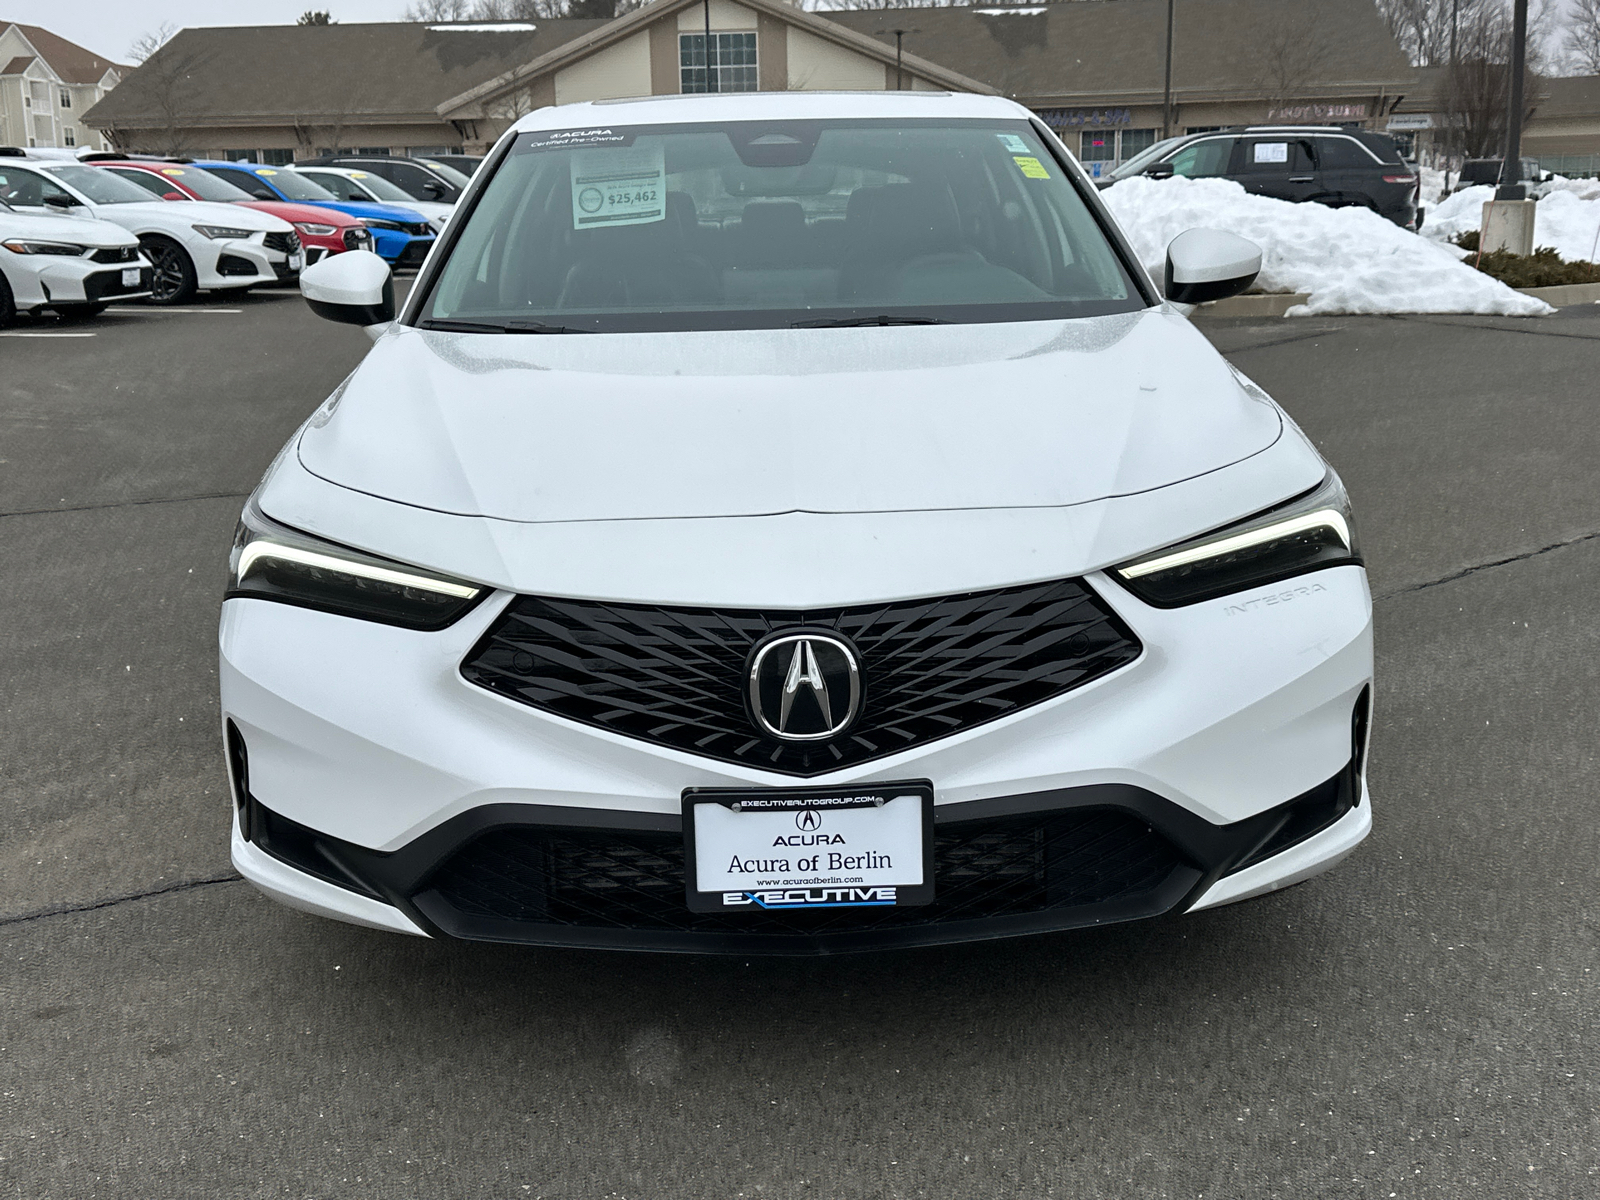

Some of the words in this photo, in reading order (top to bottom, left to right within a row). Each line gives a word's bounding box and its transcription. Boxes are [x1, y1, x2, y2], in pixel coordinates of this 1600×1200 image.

[560, 129, 612, 138] ACURA
[530, 138, 569, 148] Certified
[570, 135, 625, 144] Pre-Owned
[608, 190, 657, 207] $25,462
[1223, 583, 1327, 616] INTEGRA
[740, 795, 875, 807] EXECUTIVEAUTOGROUP.COM
[772, 833, 846, 847] ACURA
[727, 855, 791, 873] Acura
[797, 855, 820, 872] of
[827, 850, 893, 871] Berlin
[756, 875, 864, 887] www.acuraofberlin.com
[722, 886, 897, 906] EXECUTIVE
